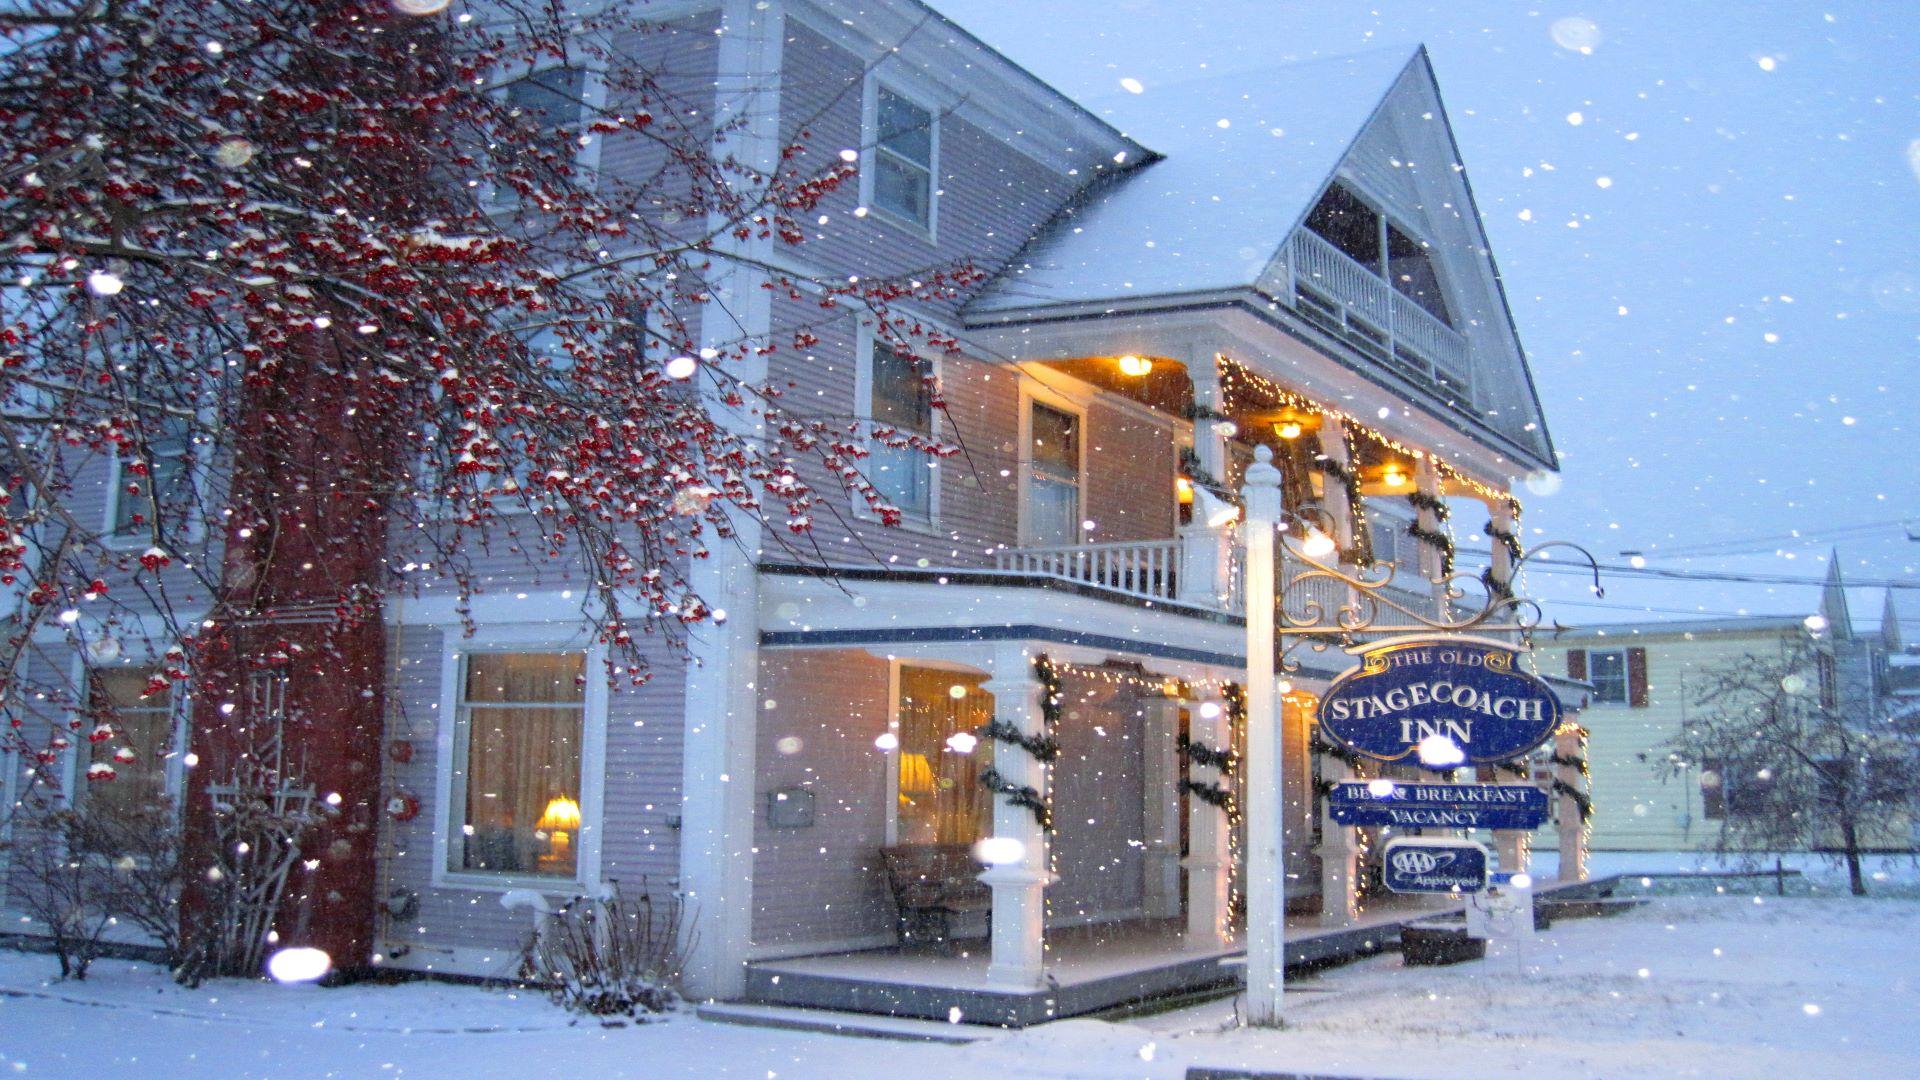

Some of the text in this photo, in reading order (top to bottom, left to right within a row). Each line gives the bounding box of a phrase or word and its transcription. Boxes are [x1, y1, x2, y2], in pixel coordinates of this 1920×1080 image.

[1391, 651, 1482, 666] THE OLD
[1331, 681, 1543, 721] STAGECOACH
[1400, 718, 1473, 743] INN
[1347, 786, 1388, 799] BE
[1416, 788, 1529, 802] BREAKFAST
[1389, 810, 1480, 824] VACANCY
[1413, 874, 1478, 887] Approved
